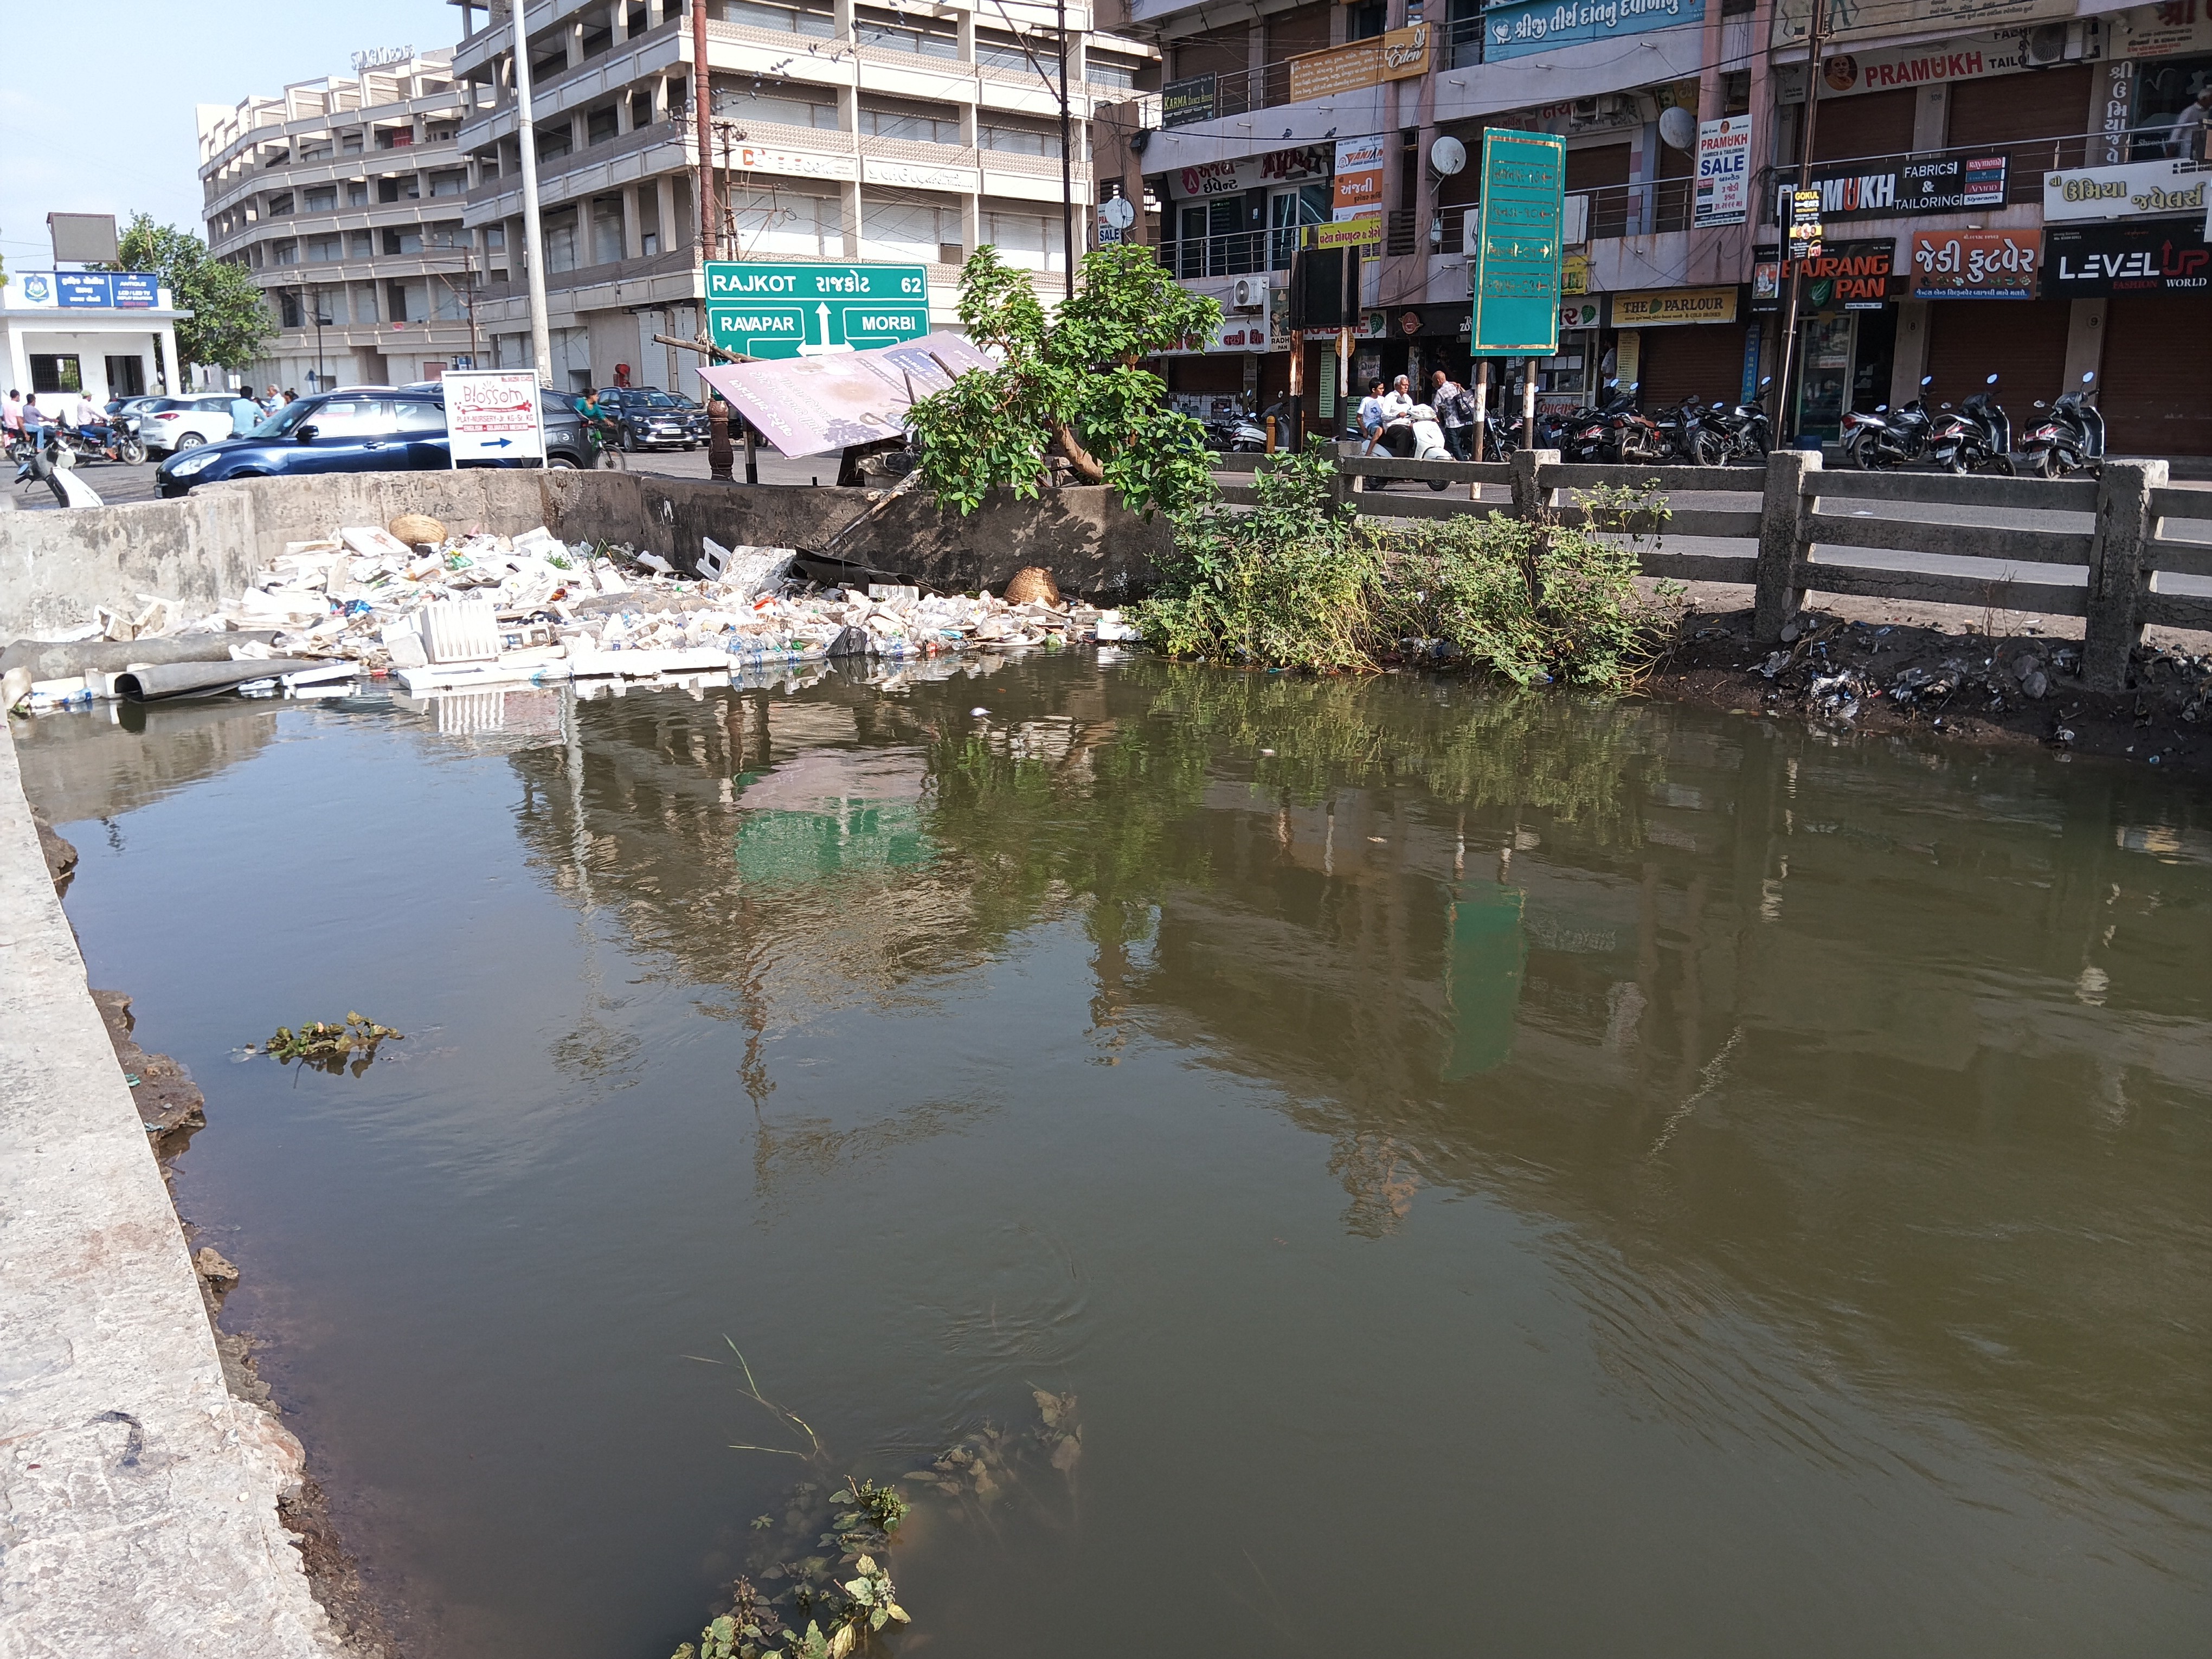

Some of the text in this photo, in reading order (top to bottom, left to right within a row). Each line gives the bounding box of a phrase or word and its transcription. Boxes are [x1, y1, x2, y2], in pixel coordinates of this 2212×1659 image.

[1515, 13, 1547, 39] શ્રીજી
[1385, 43, 1423, 69] Eden
[1865, 50, 1984, 88] PRAMUKH
[2108, 60, 2133, 79] શ્રી
[1164, 95, 1187, 111] KARMA
[1701, 133, 1748, 151] PRAMUKH
[1701, 155, 1745, 176] SALE
[1904, 163, 1954, 178] FABRICS
[1969, 158, 2002, 169] Raymond
[1341, 177, 1373, 195] અંજની
[1922, 181, 1935, 193] &
[2048, 175, 2207, 210] શ્રી ઉમિયા જવેલર્સ
[1795, 191, 1819, 201] GOKUL
[1894, 195, 1960, 210] TAILORING
[1099, 228, 1120, 242] SALE
[1915, 240, 1960, 273] જેડી
[2059, 240, 2210, 279] LEVEL UP
[712, 269, 922, 293] RAJKOT રાજકોટ 62
[1835, 278, 1885, 299] PAN
[2112, 277, 2208, 290] FASHION WORLD
[1623, 298, 1724, 313] THE PARLOUR
[721, 317, 795, 332] RAVAPAR
[862, 316, 916, 331] MORBI
[1909, 322, 1917, 331] 8
[2091, 316, 2098, 325] 9
